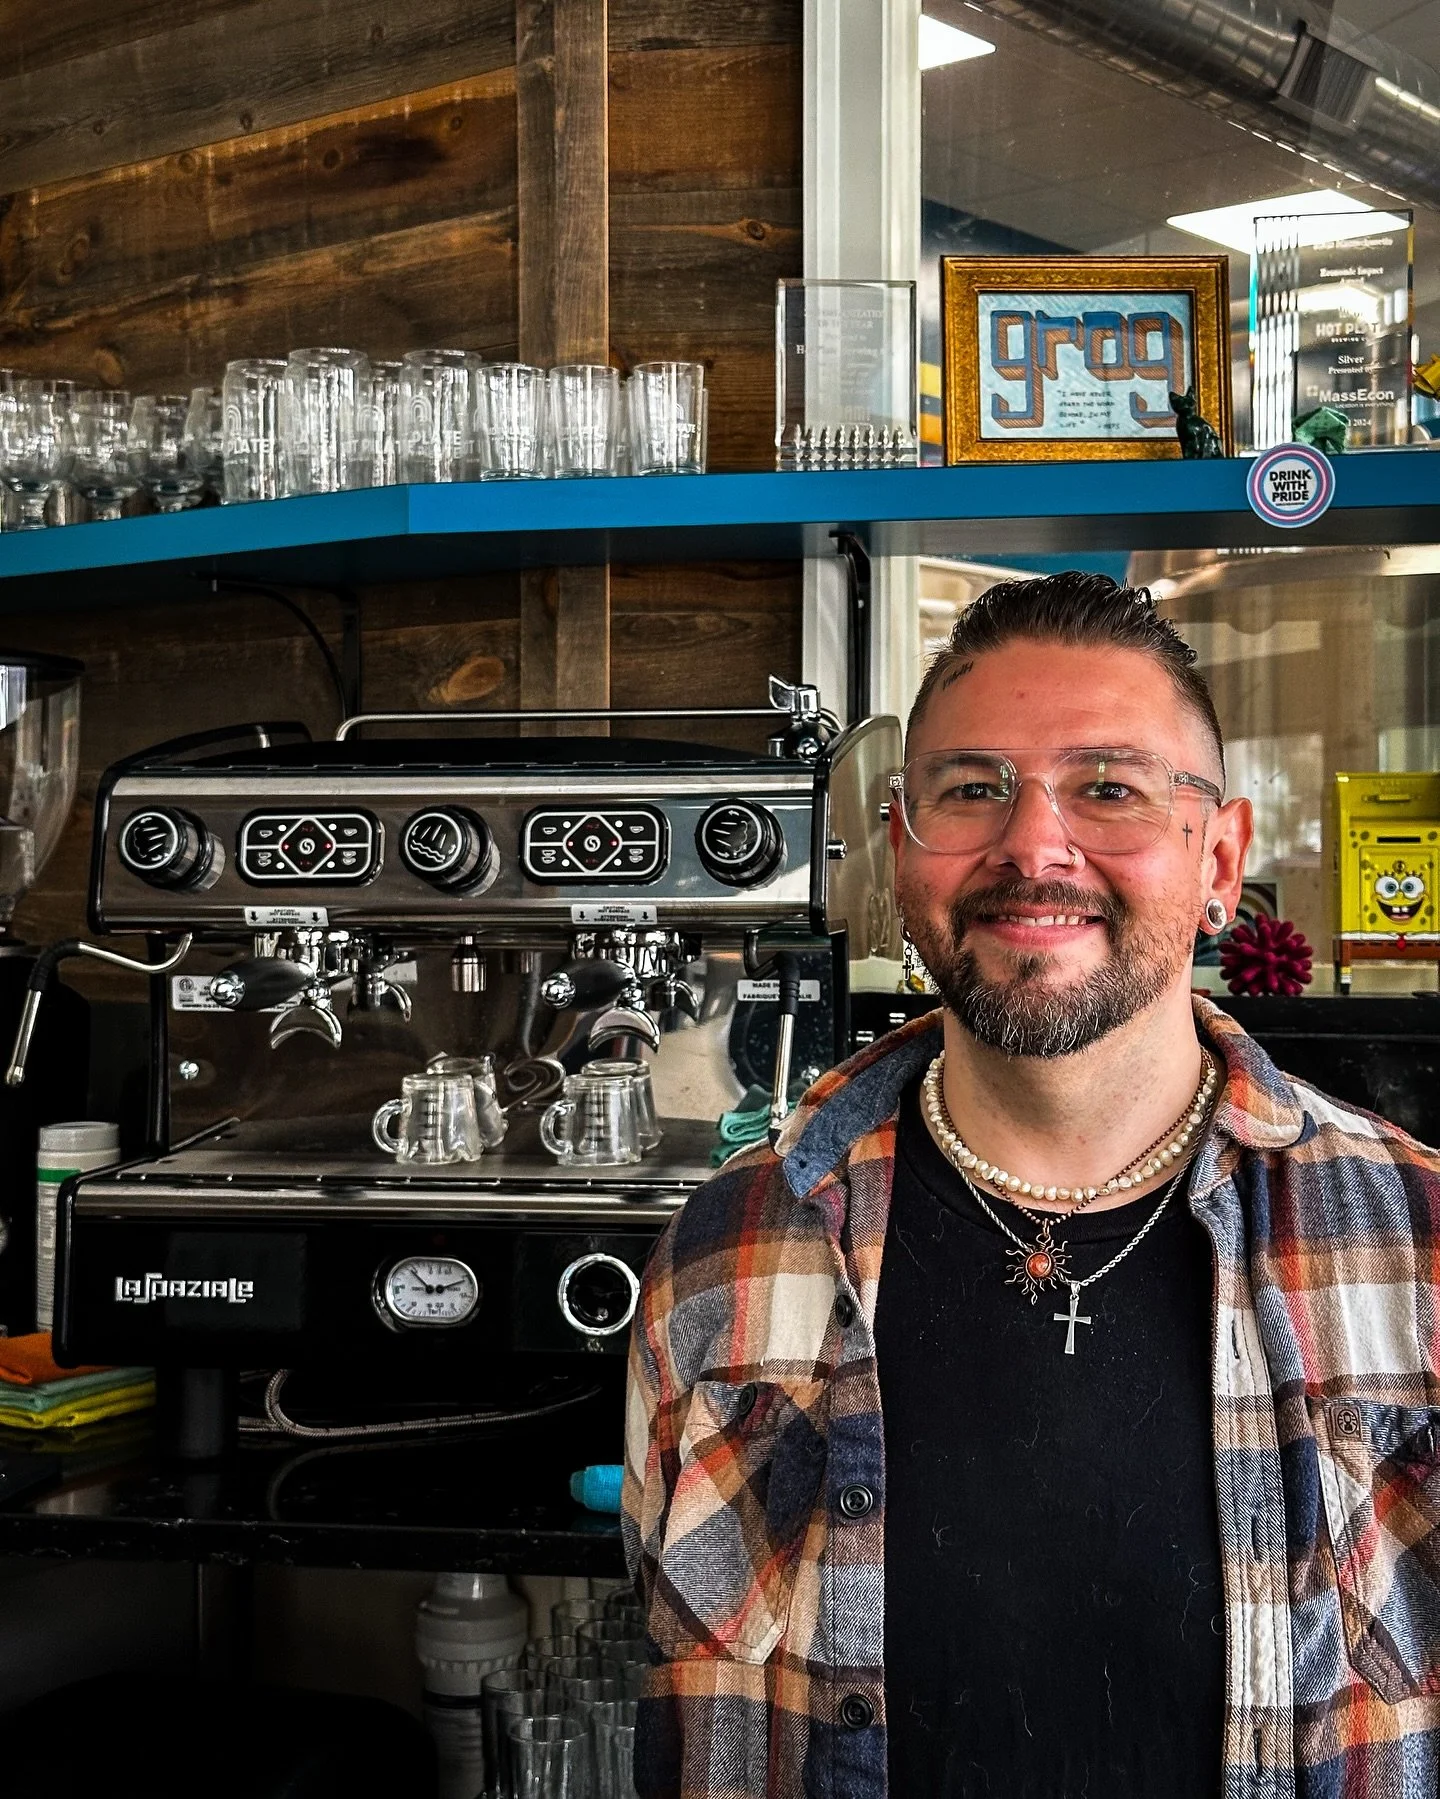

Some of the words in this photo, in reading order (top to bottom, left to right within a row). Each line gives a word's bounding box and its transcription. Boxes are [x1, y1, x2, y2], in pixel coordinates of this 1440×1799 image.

[1315, 322, 1342, 337] HOT
[1337, 355, 1365, 364] Silver
[1328, 366, 1364, 375] Presented
[1319, 388, 1395, 402] MassEcon
[1353, 418, 1372, 427] 2024
[1269, 469, 1312, 481] DRINK
[1273, 480, 1307, 491] WITH
[1272, 491, 1309, 502] PRIDE
